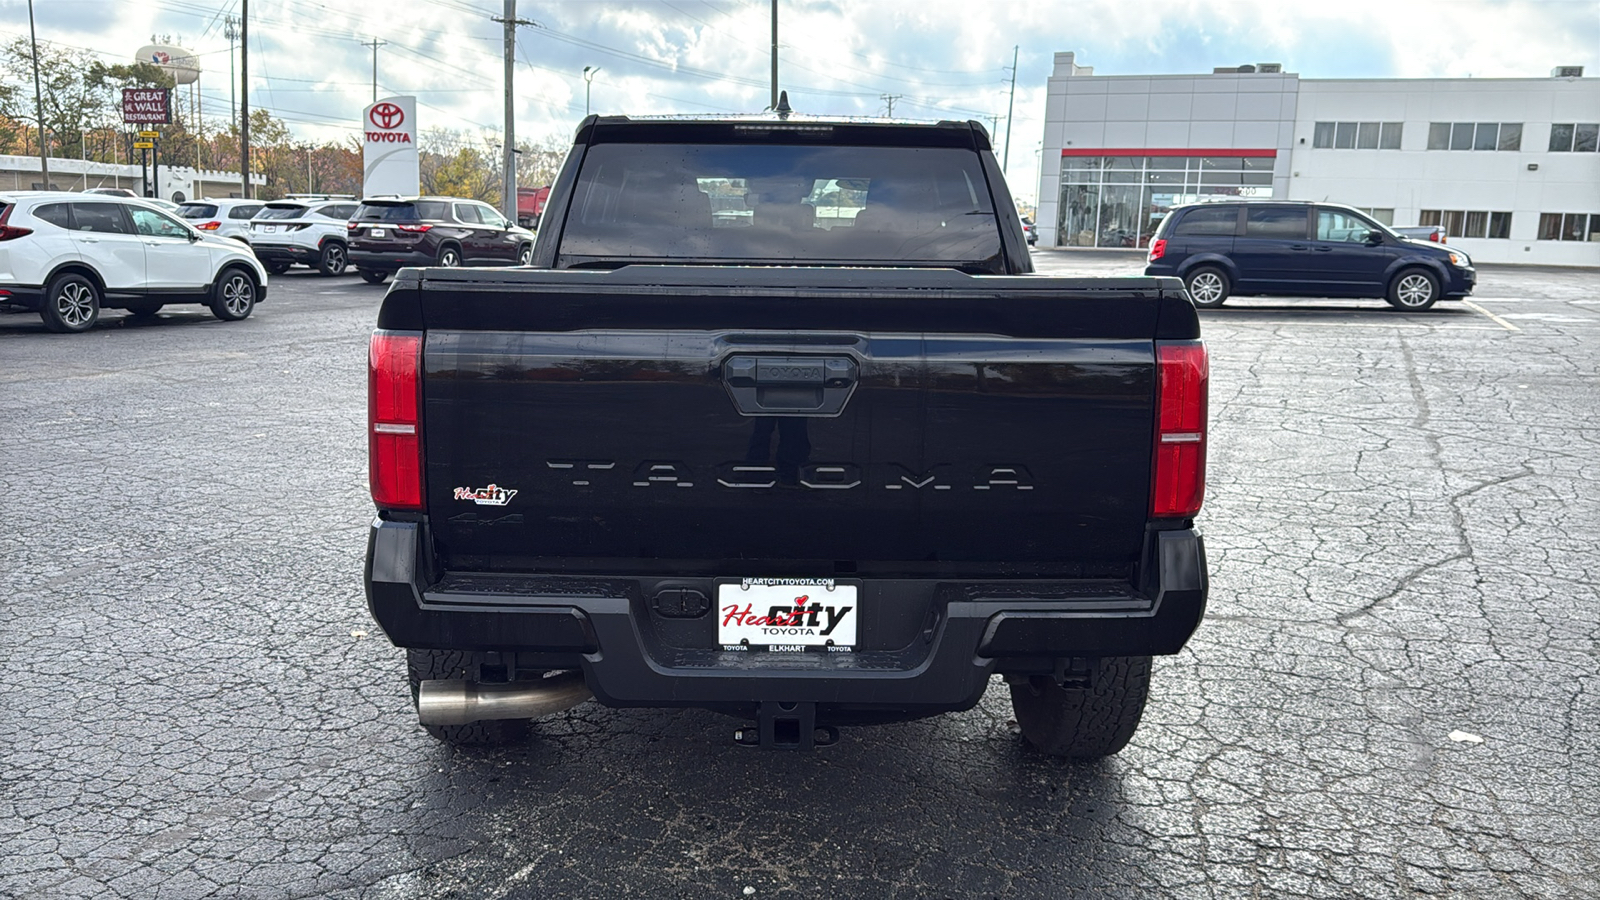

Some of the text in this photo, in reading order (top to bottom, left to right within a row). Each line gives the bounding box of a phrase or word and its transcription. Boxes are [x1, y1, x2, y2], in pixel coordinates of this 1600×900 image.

[133, 91, 164, 102] GREAT
[134, 102, 164, 112] WALL
[364, 131, 411, 144] TOYOTA
[760, 367, 822, 379] TOYOTA
[546, 458, 1035, 491] TACOMA
[742, 577, 835, 586] HEARTCITYTOYOTA.COM
[722, 597, 853, 636] Heart city
[761, 628, 815, 636] TOYOTA
